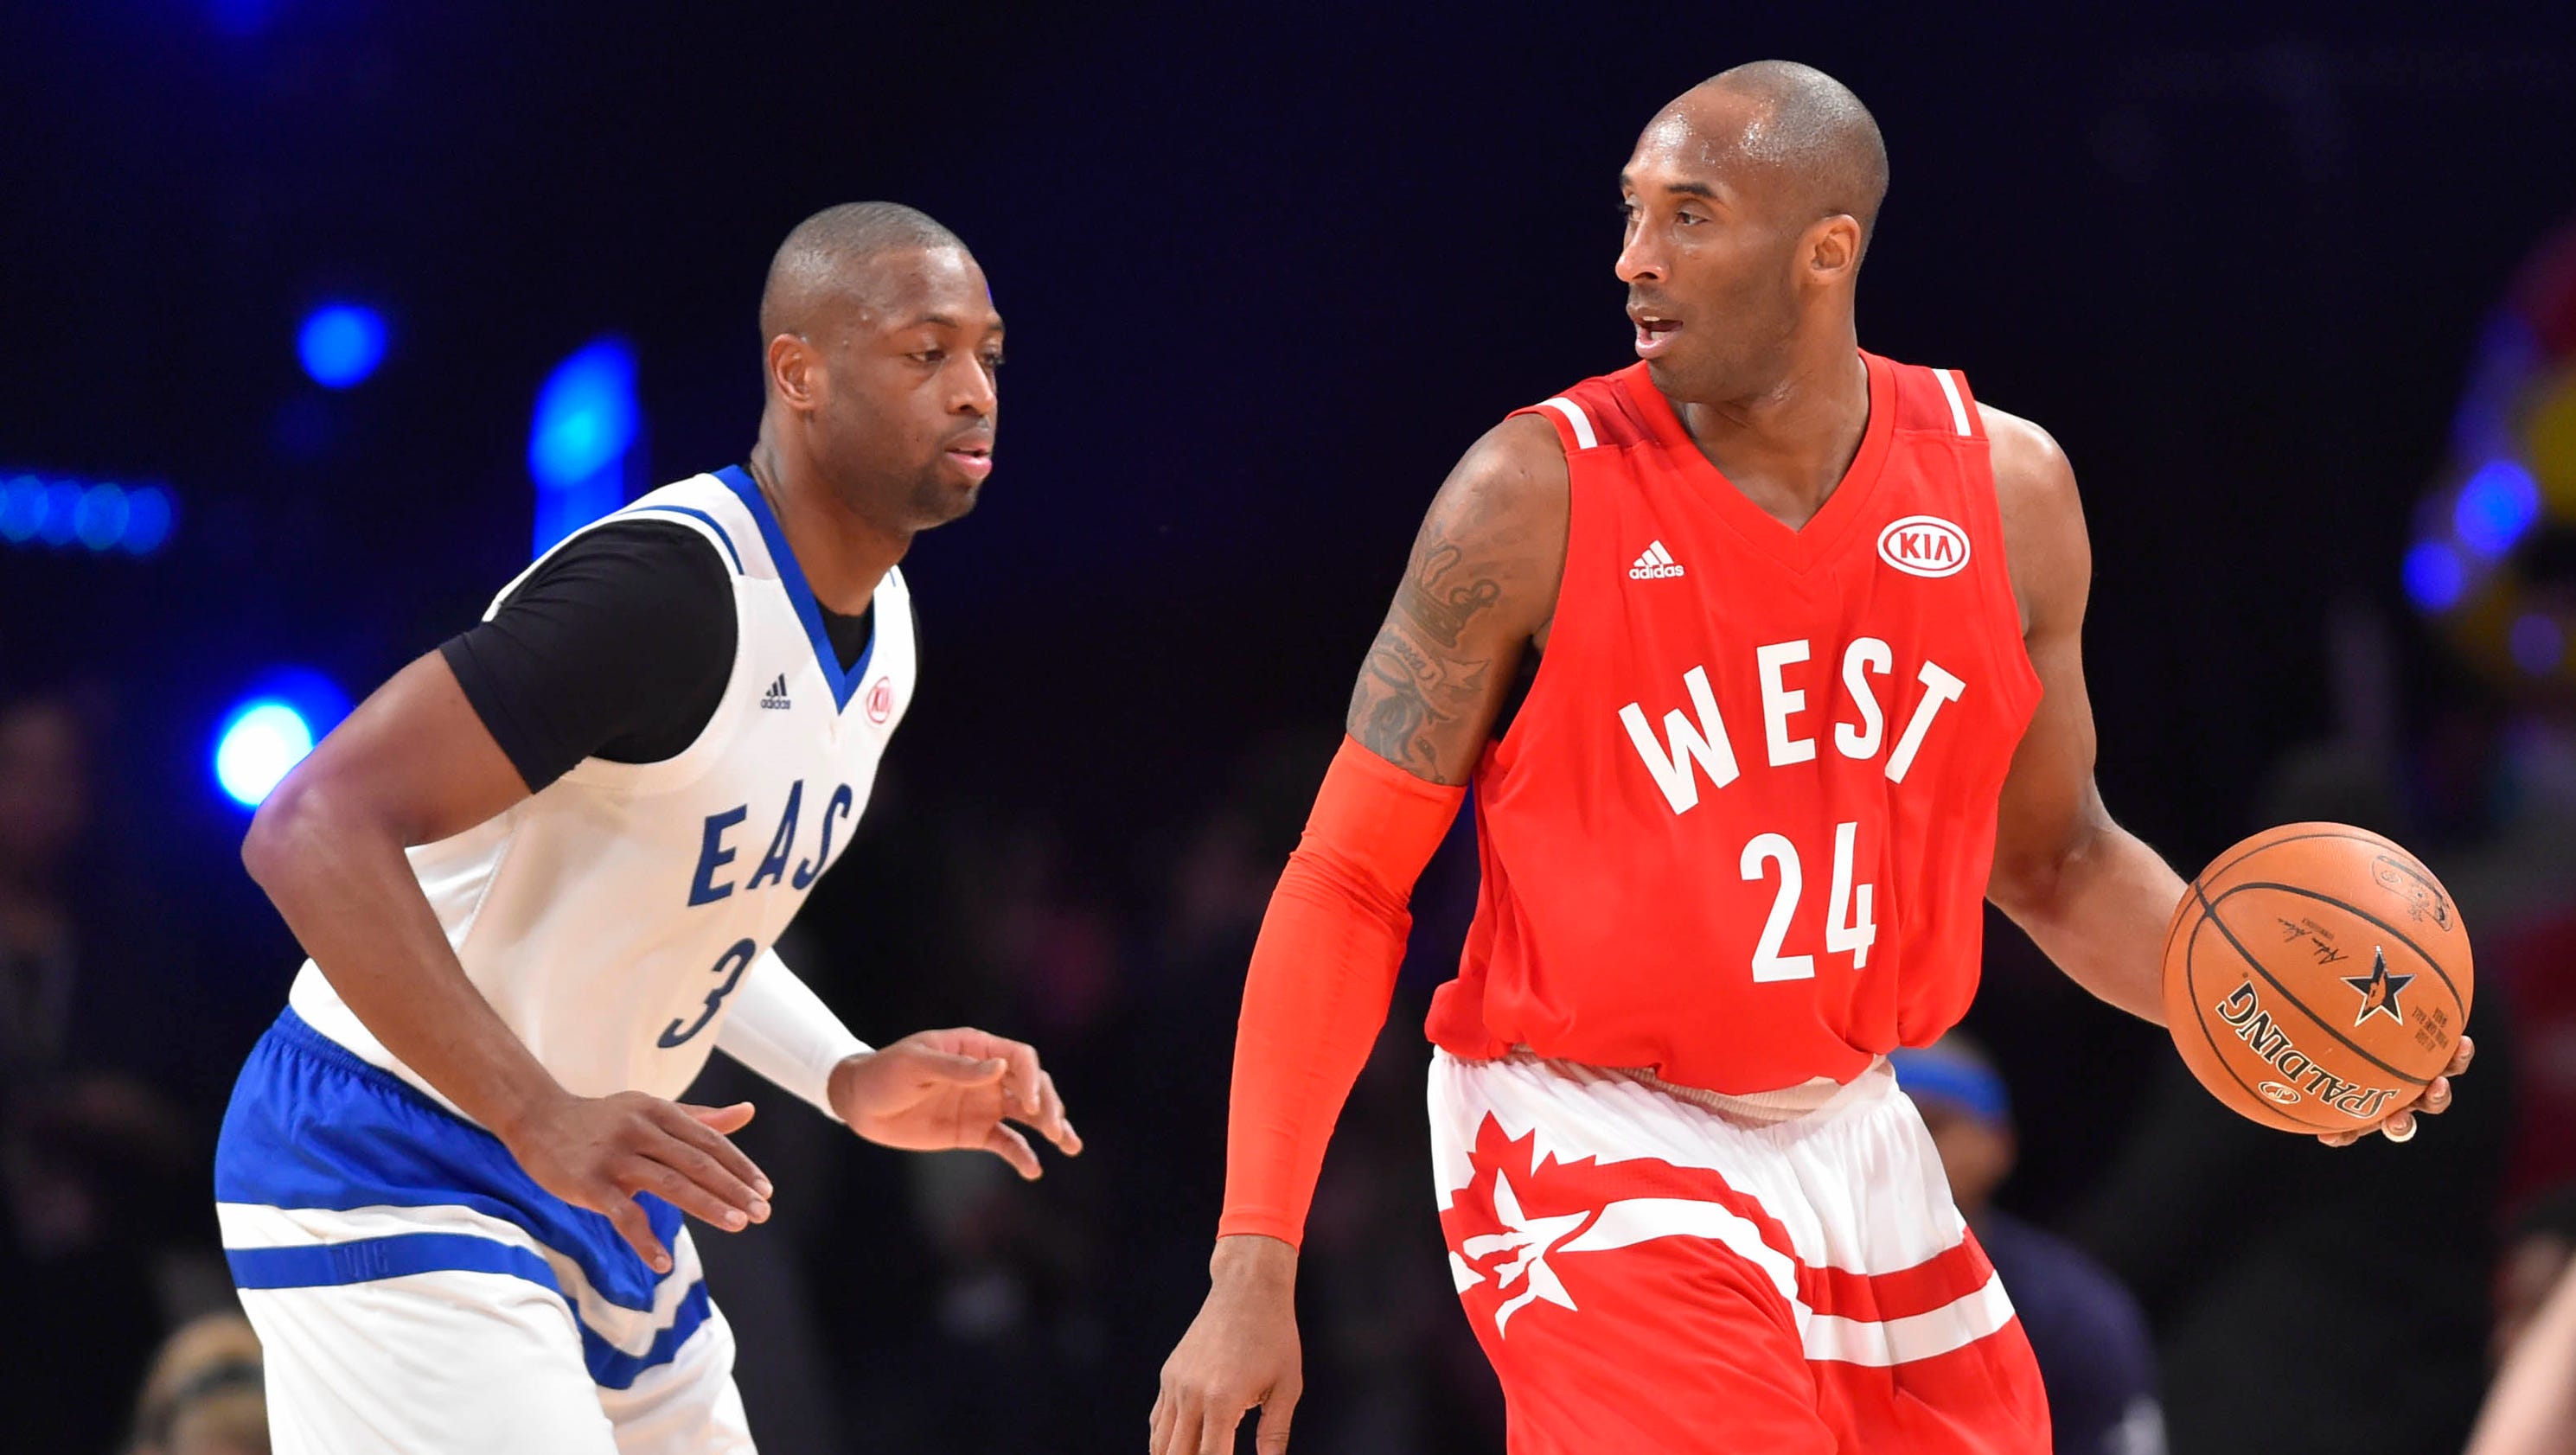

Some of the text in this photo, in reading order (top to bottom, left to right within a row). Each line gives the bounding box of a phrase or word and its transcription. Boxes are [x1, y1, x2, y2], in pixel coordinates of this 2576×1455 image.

[1628, 565, 1685, 579] adidas
[1900, 533, 1953, 562] KIA
[760, 699, 791, 710] adidas
[1618, 637, 1966, 815] WEST
[687, 779, 852, 908] EAS
[1740, 821, 1876, 983] 24
[657, 938, 757, 1049] 3
[2215, 980, 2400, 1120] SPALDING
